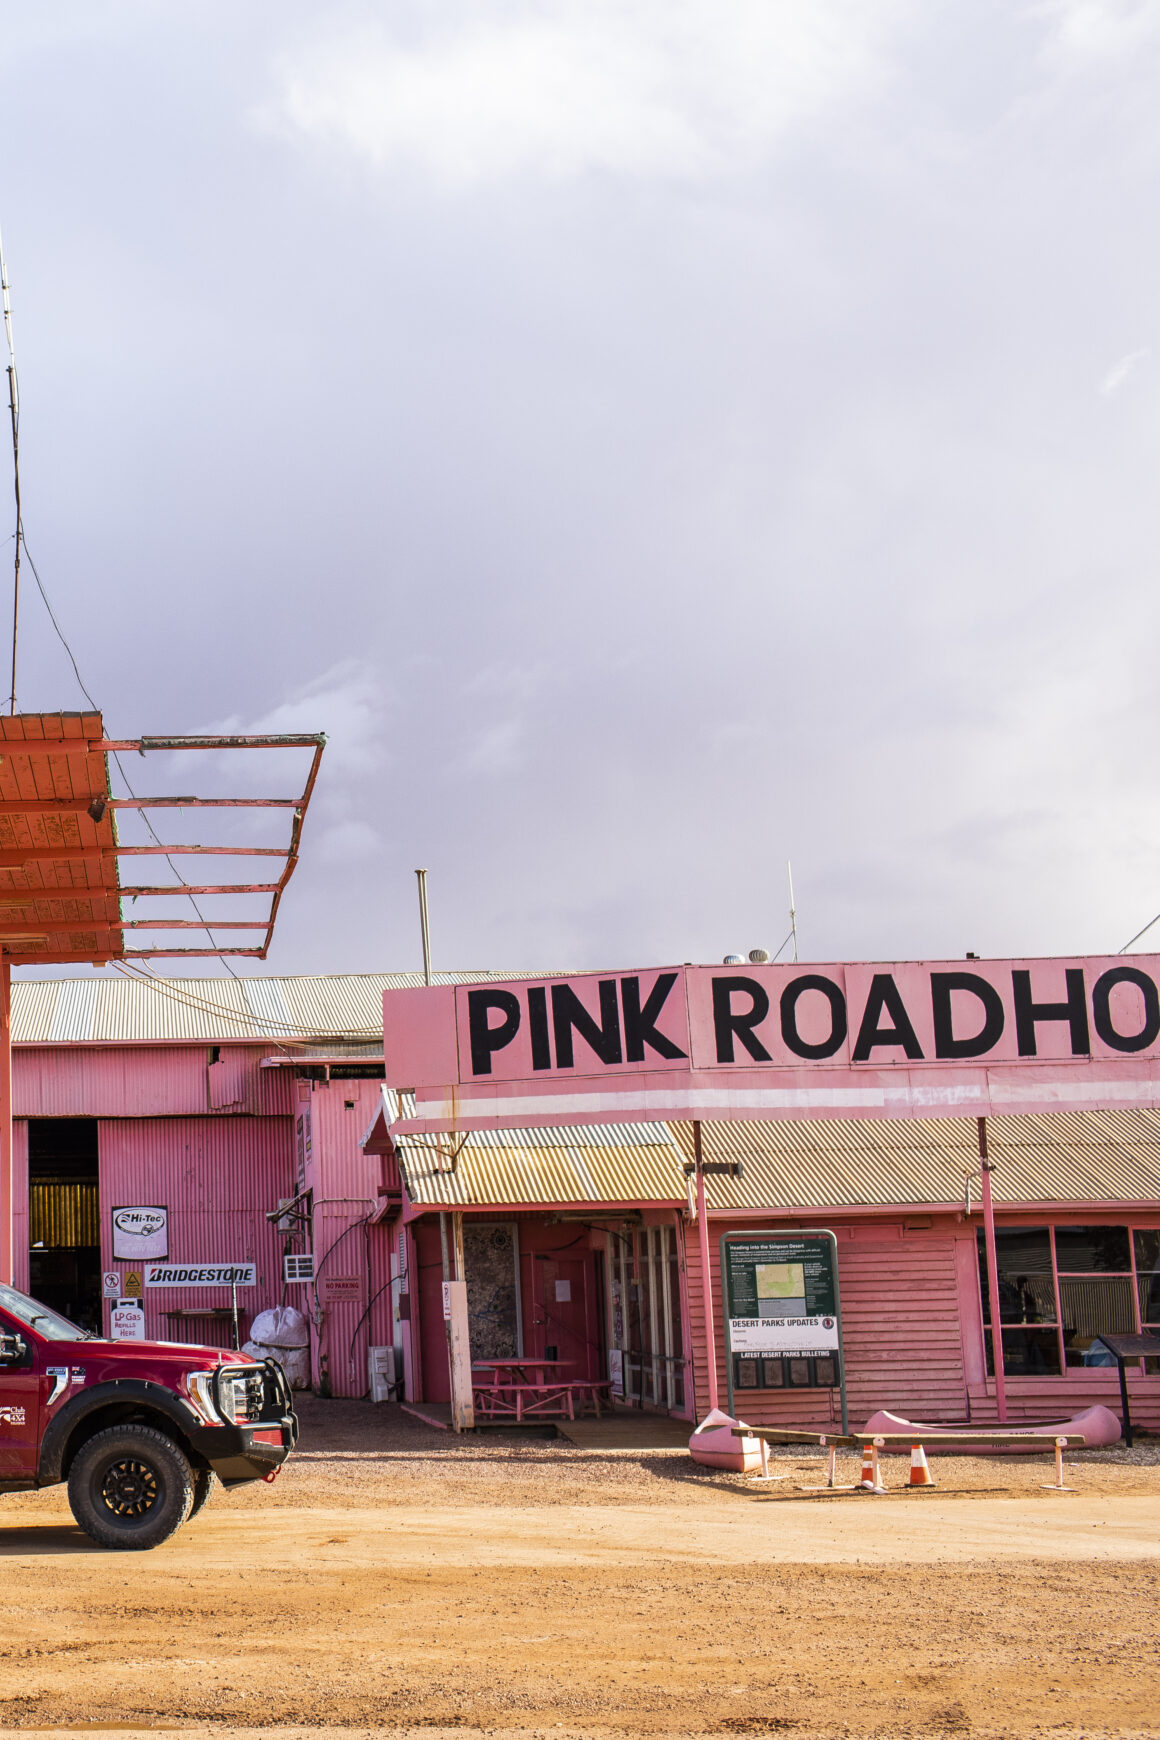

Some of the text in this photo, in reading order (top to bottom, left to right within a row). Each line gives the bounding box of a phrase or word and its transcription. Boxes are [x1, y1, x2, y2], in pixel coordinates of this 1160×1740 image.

[467, 966, 1160, 1075] PINK ROADHO
[131, 1214, 161, 1222] Hi-Tec
[149, 1268, 253, 1282] BRIDGESTONE
[114, 1312, 141, 1321] LP Gas
[733, 1319, 819, 1328] DESERT PARKS UPDATES
